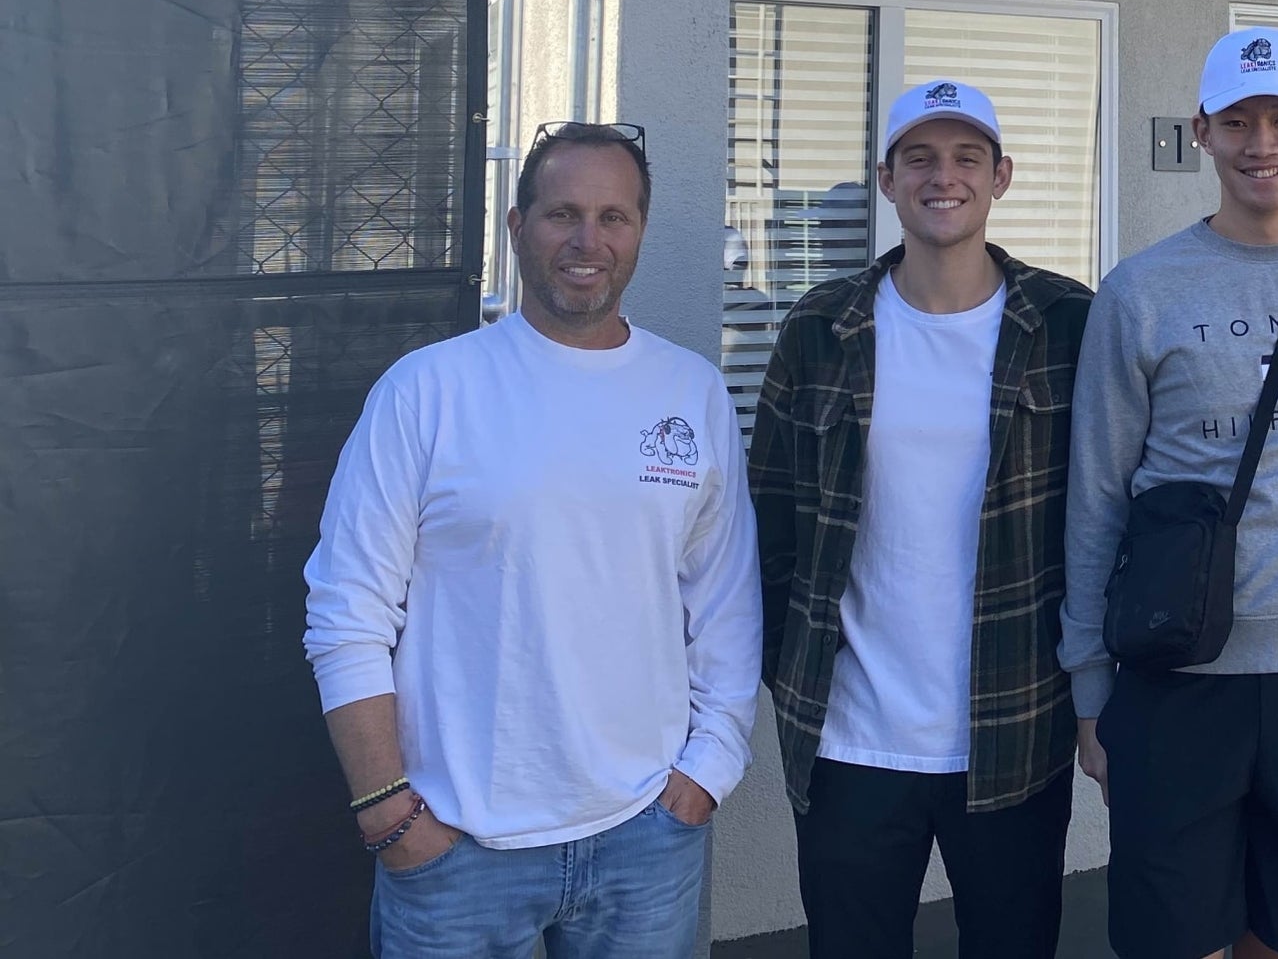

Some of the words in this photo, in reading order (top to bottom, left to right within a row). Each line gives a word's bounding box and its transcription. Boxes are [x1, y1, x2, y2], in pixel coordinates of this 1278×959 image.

[1173, 124, 1183, 164] 1
[646, 466, 696, 478] LEAKTRONICS
[639, 475, 661, 484] LEAK
